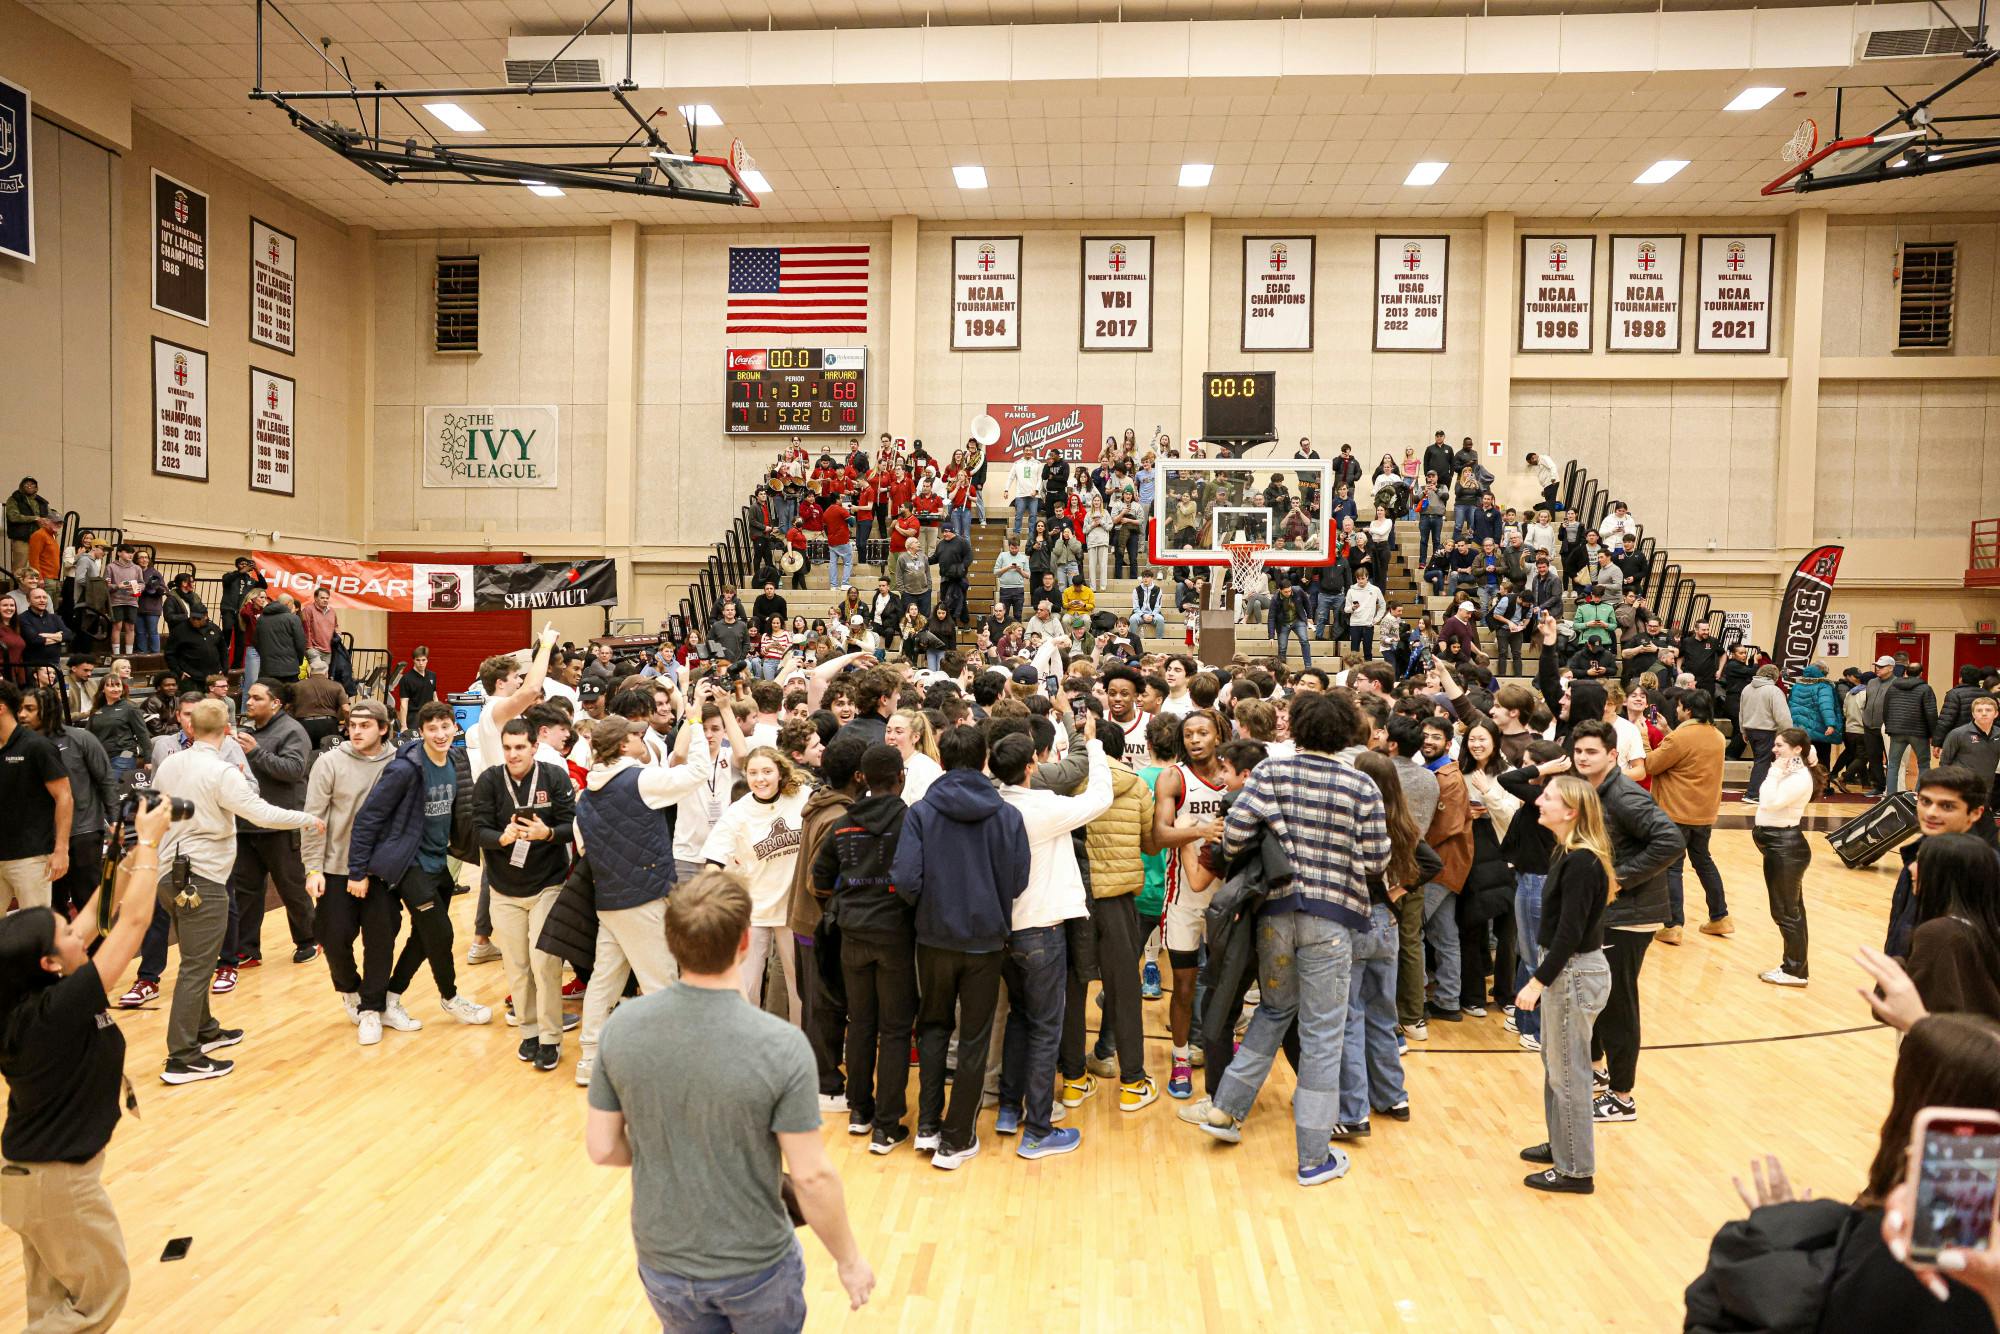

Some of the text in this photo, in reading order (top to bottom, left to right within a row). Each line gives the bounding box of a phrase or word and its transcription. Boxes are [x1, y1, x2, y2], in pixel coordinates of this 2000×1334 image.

[161, 229, 203, 257] IVY LEAGUE
[160, 243, 205, 270] CHAMPIONS
[161, 259, 180, 277] 1986
[257, 270, 291, 294] IVY LEAGUE
[982, 273, 1016, 281] BASKETBALL
[1087, 273, 1147, 281] WOMEN'S BASKETBALL
[1261, 273, 1296, 281] GYMNASTICS
[1394, 273, 1429, 281] GYMNASTICS
[1629, 273, 1663, 281] VOLLEYBALL
[1718, 273, 1752, 281] VOLLEYBALL
[256, 282, 292, 305] CHAMPIONS
[967, 286, 1004, 301] NCAA
[1266, 283, 1291, 294] ECAC
[1398, 282, 1424, 293] USAG
[1538, 287, 1576, 302] NCAA
[1626, 286, 1665, 301] NCAA
[1718, 287, 1751, 300] NCAA
[956, 301, 1016, 312] TOURNAMENT
[1101, 291, 1132, 309] WBI
[1250, 294, 1306, 305] CHAMPIONS
[1380, 294, 1442, 305] TEAM FINALIST
[1704, 301, 1765, 312] TOURNAMENT
[1251, 307, 1275, 318] 2014
[1385, 307, 1438, 318] 2013 2016
[1526, 302, 1589, 313] TOURNAMENT
[1613, 301, 1677, 313] TOURNAMENT
[964, 318, 1006, 337] 1994
[1095, 319, 1138, 337] 2017
[1383, 320, 1409, 331] 2022
[1536, 320, 1579, 338] 1996
[1623, 320, 1666, 338] 1998
[1711, 320, 1755, 338] 2021
[770, 350, 809, 369] 00.0
[737, 371, 761, 381] BROWN
[784, 375, 805, 383] PERIOD
[824, 371, 858, 380] HARVARD
[741, 382, 763, 400] 71
[791, 384, 799, 398] 3
[833, 382, 857, 400] 68
[1211, 378, 1255, 397] 00.0
[175, 399, 187, 413] IVY
[161, 408, 202, 430] CHAMPIONS
[467, 414, 495, 426] THE
[740, 409, 748, 423] 7
[822, 409, 831, 423] 0
[257, 418, 290, 436] IVY LEAGUE
[1005, 409, 1084, 452] Narragansett
[184, 428, 201, 443] 2013
[256, 430, 291, 448] CHAMPIONS
[162, 440, 180, 454] 2014
[465, 428, 537, 461] IVY
[895, 439, 906, 450] R
[1188, 439, 1199, 452] S
[1490, 442, 1501, 454] T
[161, 455, 180, 470] 2023
[466, 463, 537, 479] LEAGUE
[257, 473, 272, 485] 2021
[261, 568, 409, 600] HIGHBAR
[429, 572, 461, 611] B
[503, 588, 589, 611] SHAWMUT
[1827, 642, 1840, 656] B
[719, 759, 728, 769] B
[536, 791, 548, 804] B
[1189, 801, 1221, 814] BRO
